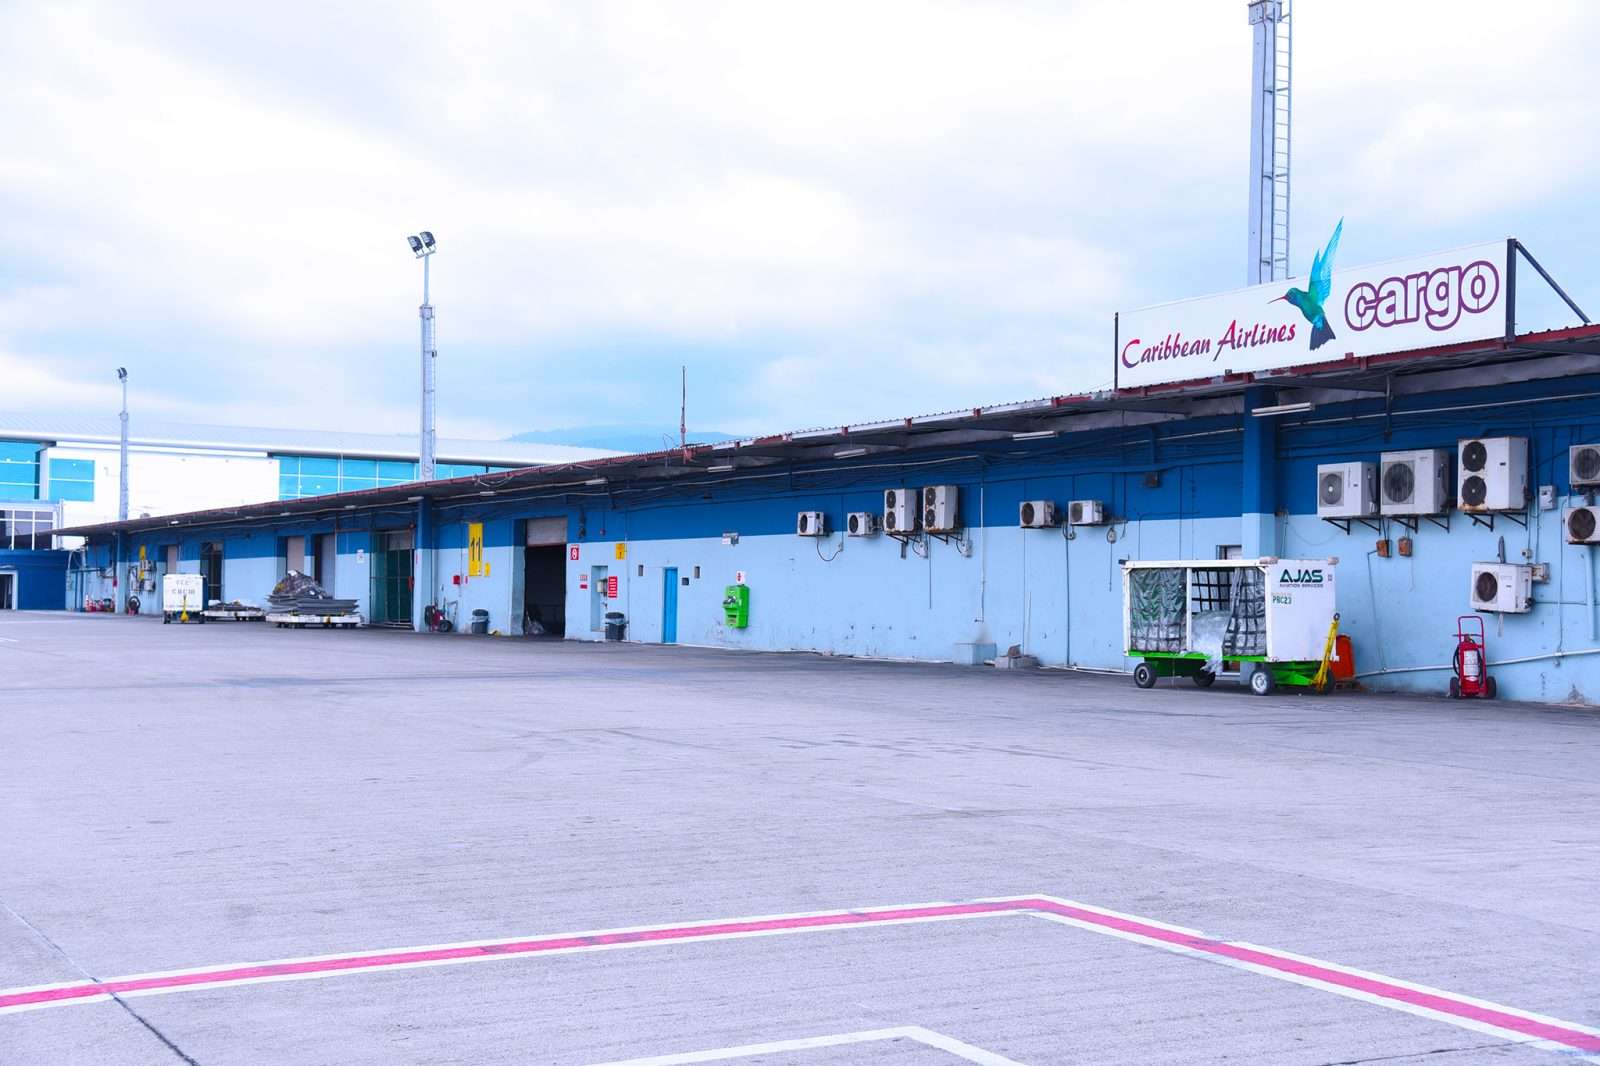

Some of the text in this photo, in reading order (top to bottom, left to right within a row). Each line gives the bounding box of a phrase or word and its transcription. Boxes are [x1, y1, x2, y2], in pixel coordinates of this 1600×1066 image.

[1345, 260, 1500, 332] cargo
[1121, 319, 1297, 369] Caribbean Airlines
[470, 536, 481, 562] 11
[1280, 569, 1323, 583] AJAS
